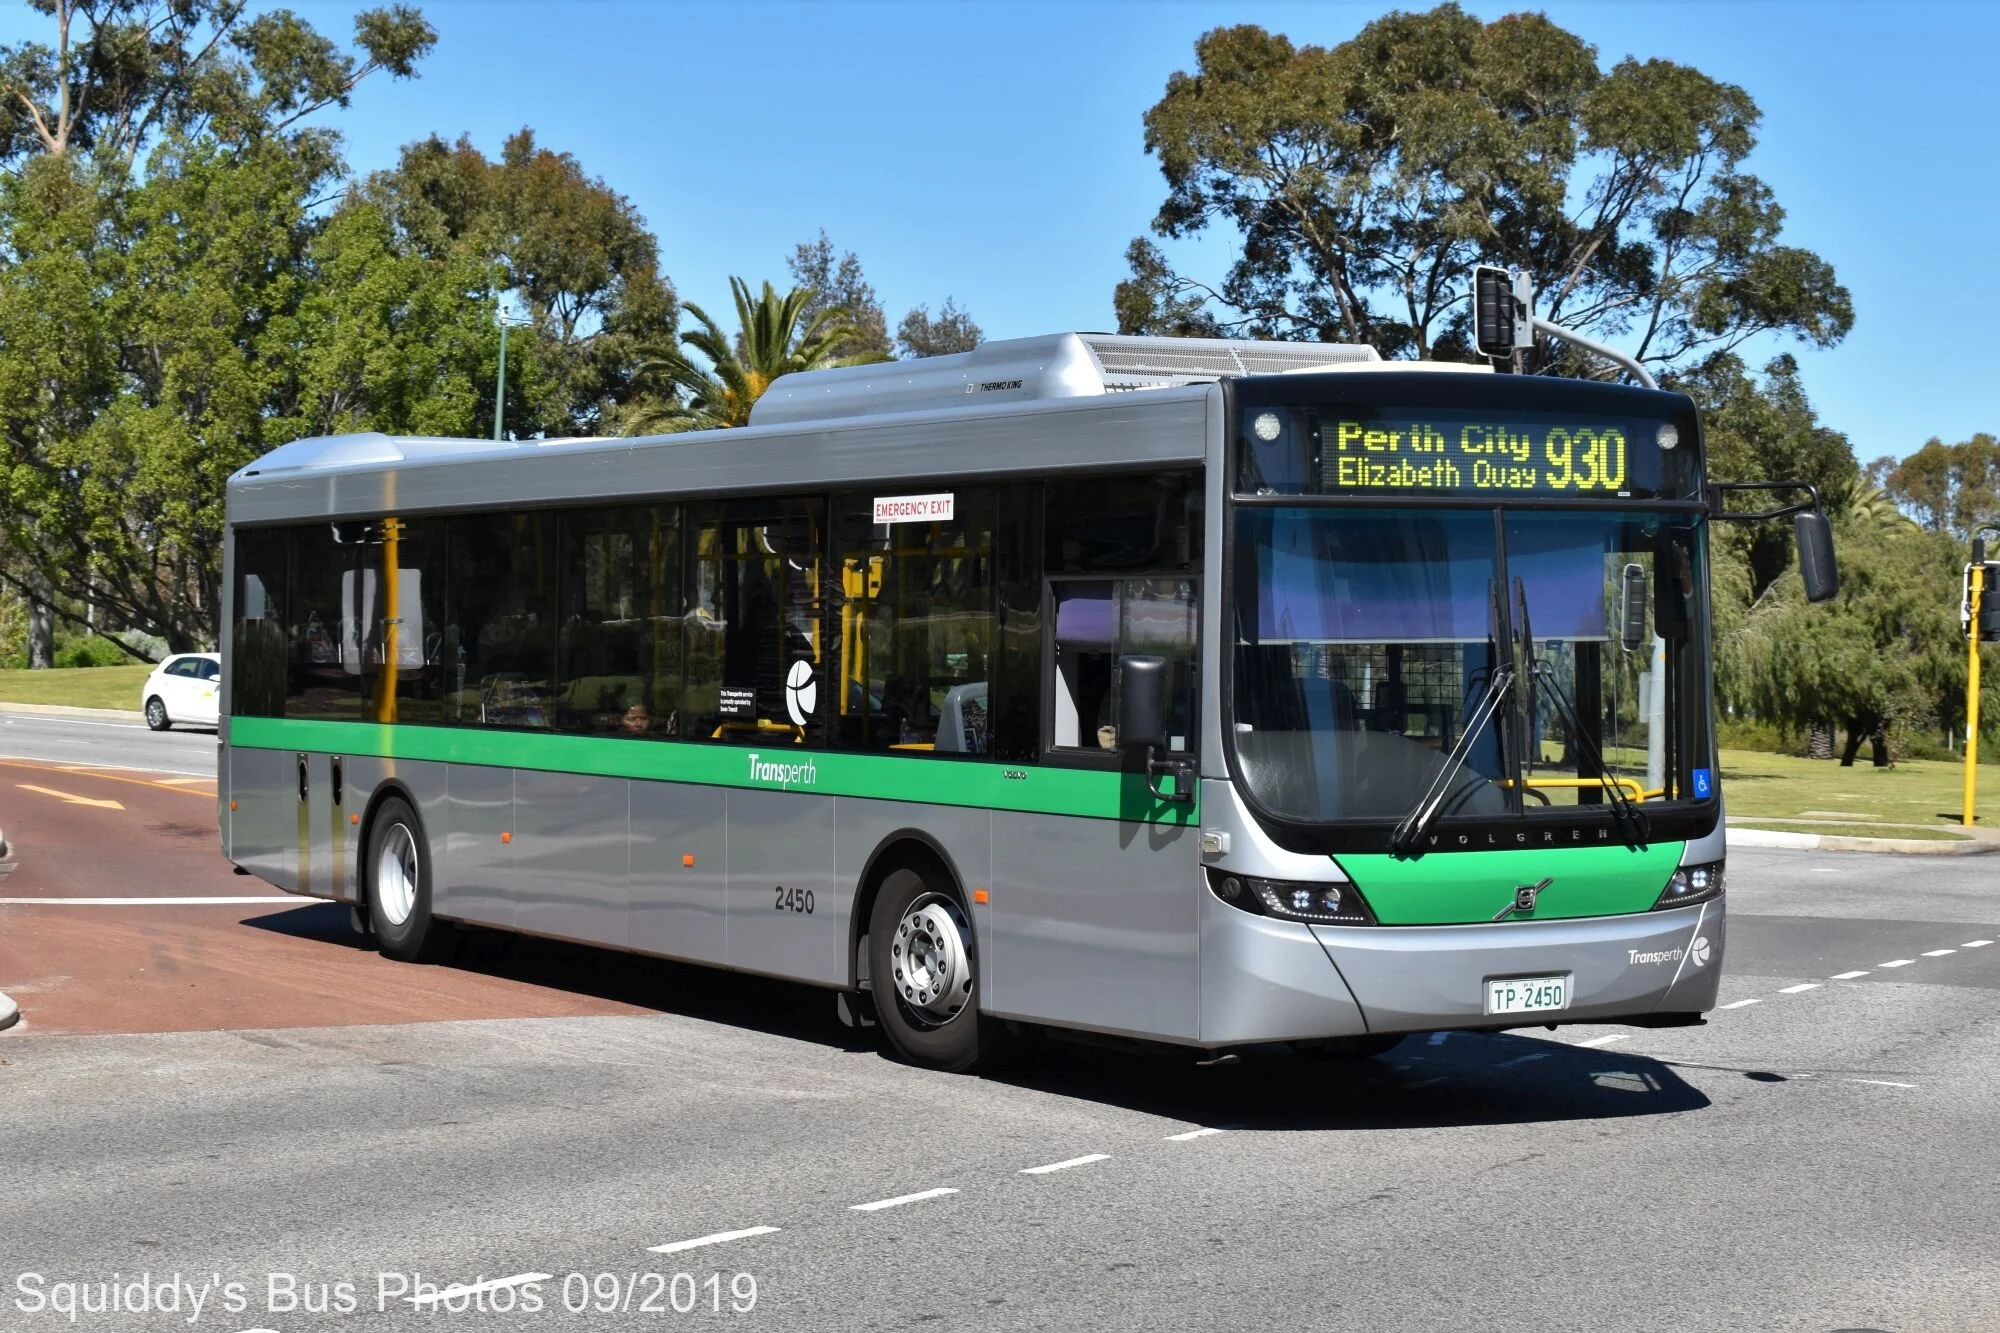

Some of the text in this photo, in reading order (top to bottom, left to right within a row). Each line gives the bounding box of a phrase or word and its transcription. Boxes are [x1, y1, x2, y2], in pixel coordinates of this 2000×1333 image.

[981, 379, 1022, 391] THERMO KING
[1338, 421, 1530, 461] Perth City
[1545, 427, 1624, 489] 930
[1338, 457, 1536, 488] Elizabeth Quay
[876, 500, 951, 516] EMERGENCY EXIT
[749, 753, 816, 790] Transperth
[1430, 829, 1608, 846] VOLGREN
[775, 886, 815, 914] 2450
[1628, 946, 1683, 966] Transperth
